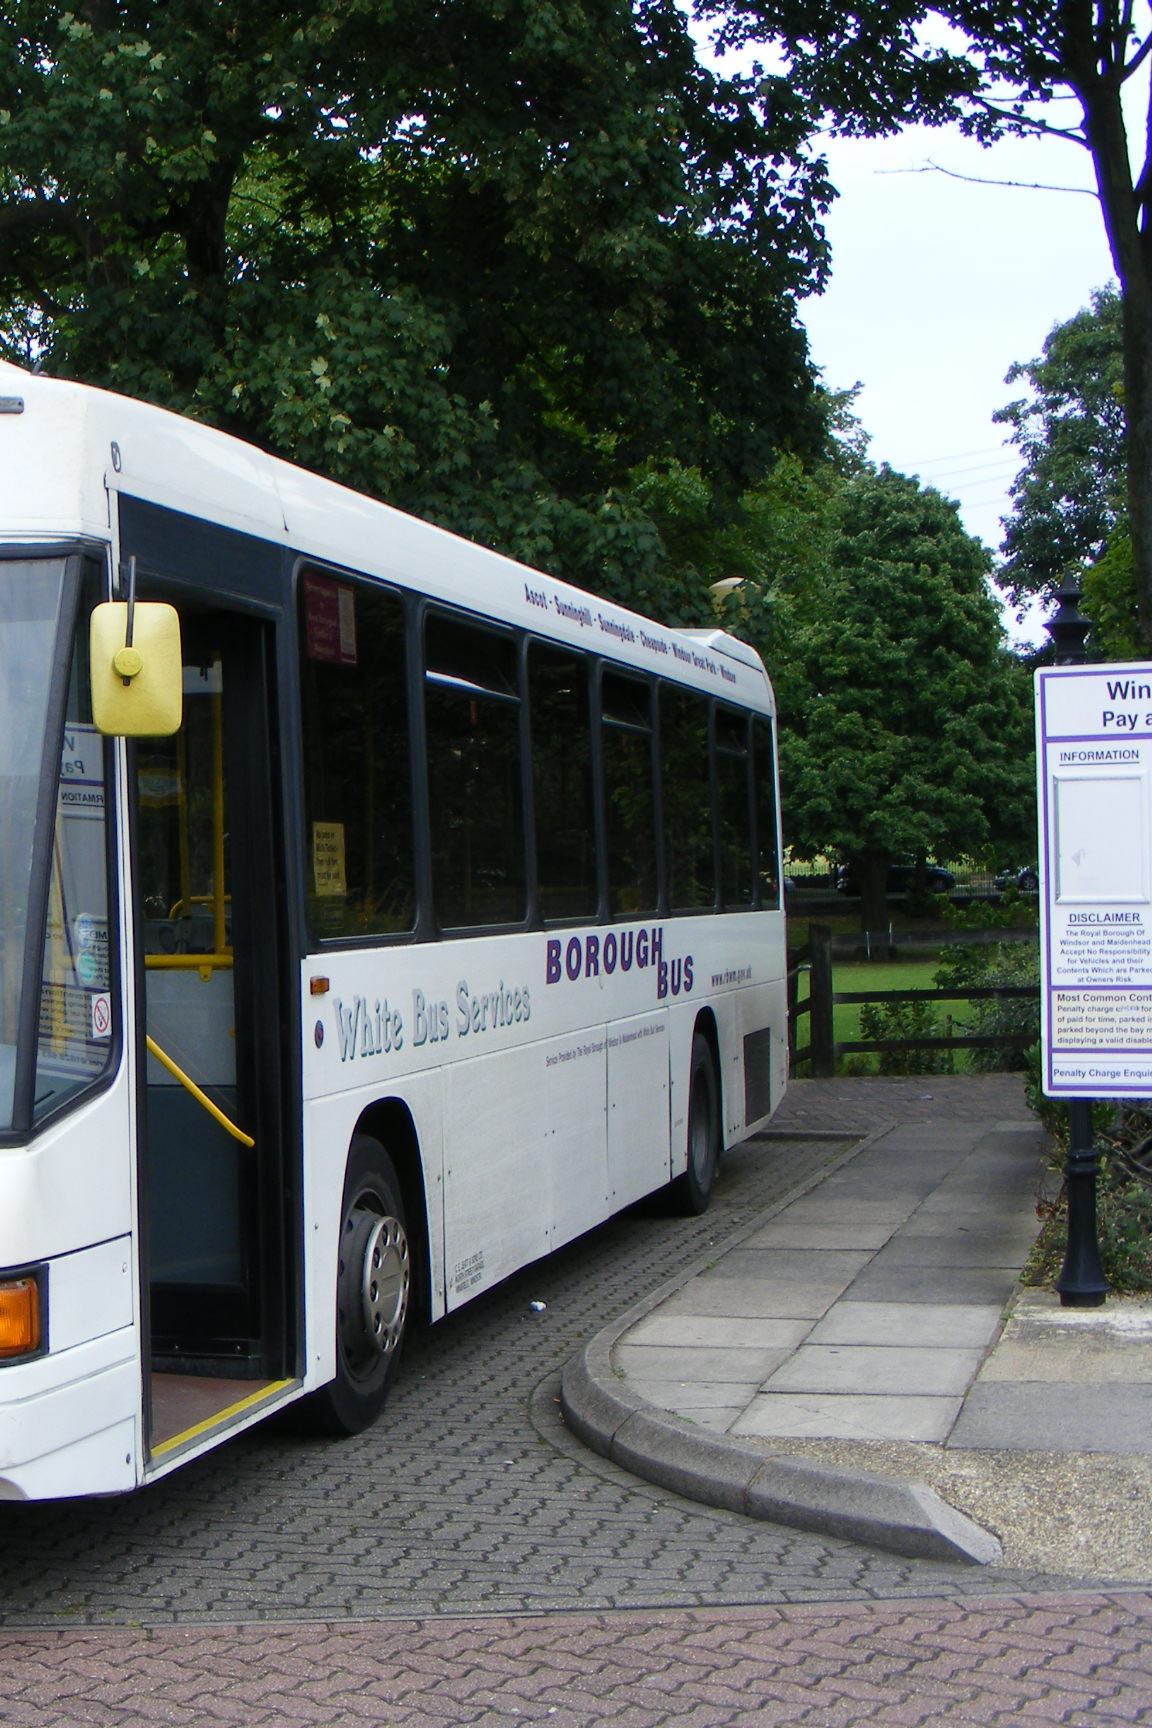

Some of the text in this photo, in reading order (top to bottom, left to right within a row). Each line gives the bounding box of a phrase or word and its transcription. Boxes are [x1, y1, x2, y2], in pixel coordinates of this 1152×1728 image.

[524, 583, 548, 610] Ascot
[1107, 680, 1152, 700] Win
[1103, 711, 1138, 731] Pay
[1060, 749, 1139, 762] INFORMATION
[1069, 912, 1140, 923] DISCLAIMER
[1080, 929, 1101, 938] Royal
[1103, 929, 1135, 938] Borough
[1107, 938, 1151, 946] Maidenhead
[546, 927, 663, 985] BOROUGH
[1060, 948, 1085, 956] Accept
[1099, 947, 1151, 956] Responsibility
[1056, 966, 1089, 974] Contents
[1091, 966, 1114, 974] Which
[657, 955, 694, 1000] BUS
[1057, 993, 1080, 1002] Most
[1082, 993, 1126, 1002] Common
[1057, 1005, 1085, 1014] Penalty
[1087, 1005, 1114, 1014] charge
[332, 979, 531, 1063] White Bus Services
[1067, 1016, 1084, 1024] paid
[1119, 1016, 1146, 1024] parked
[1057, 1026, 1084, 1034] parked
[1085, 1026, 1114, 1035] beyond
[1130, 1026, 1144, 1035] bay
[1057, 1036, 1097, 1045] displaying
[1105, 1036, 1124, 1044] valid
[1053, 1068, 1087, 1079] Penalty
[1088, 1068, 1121, 1079] Charge
